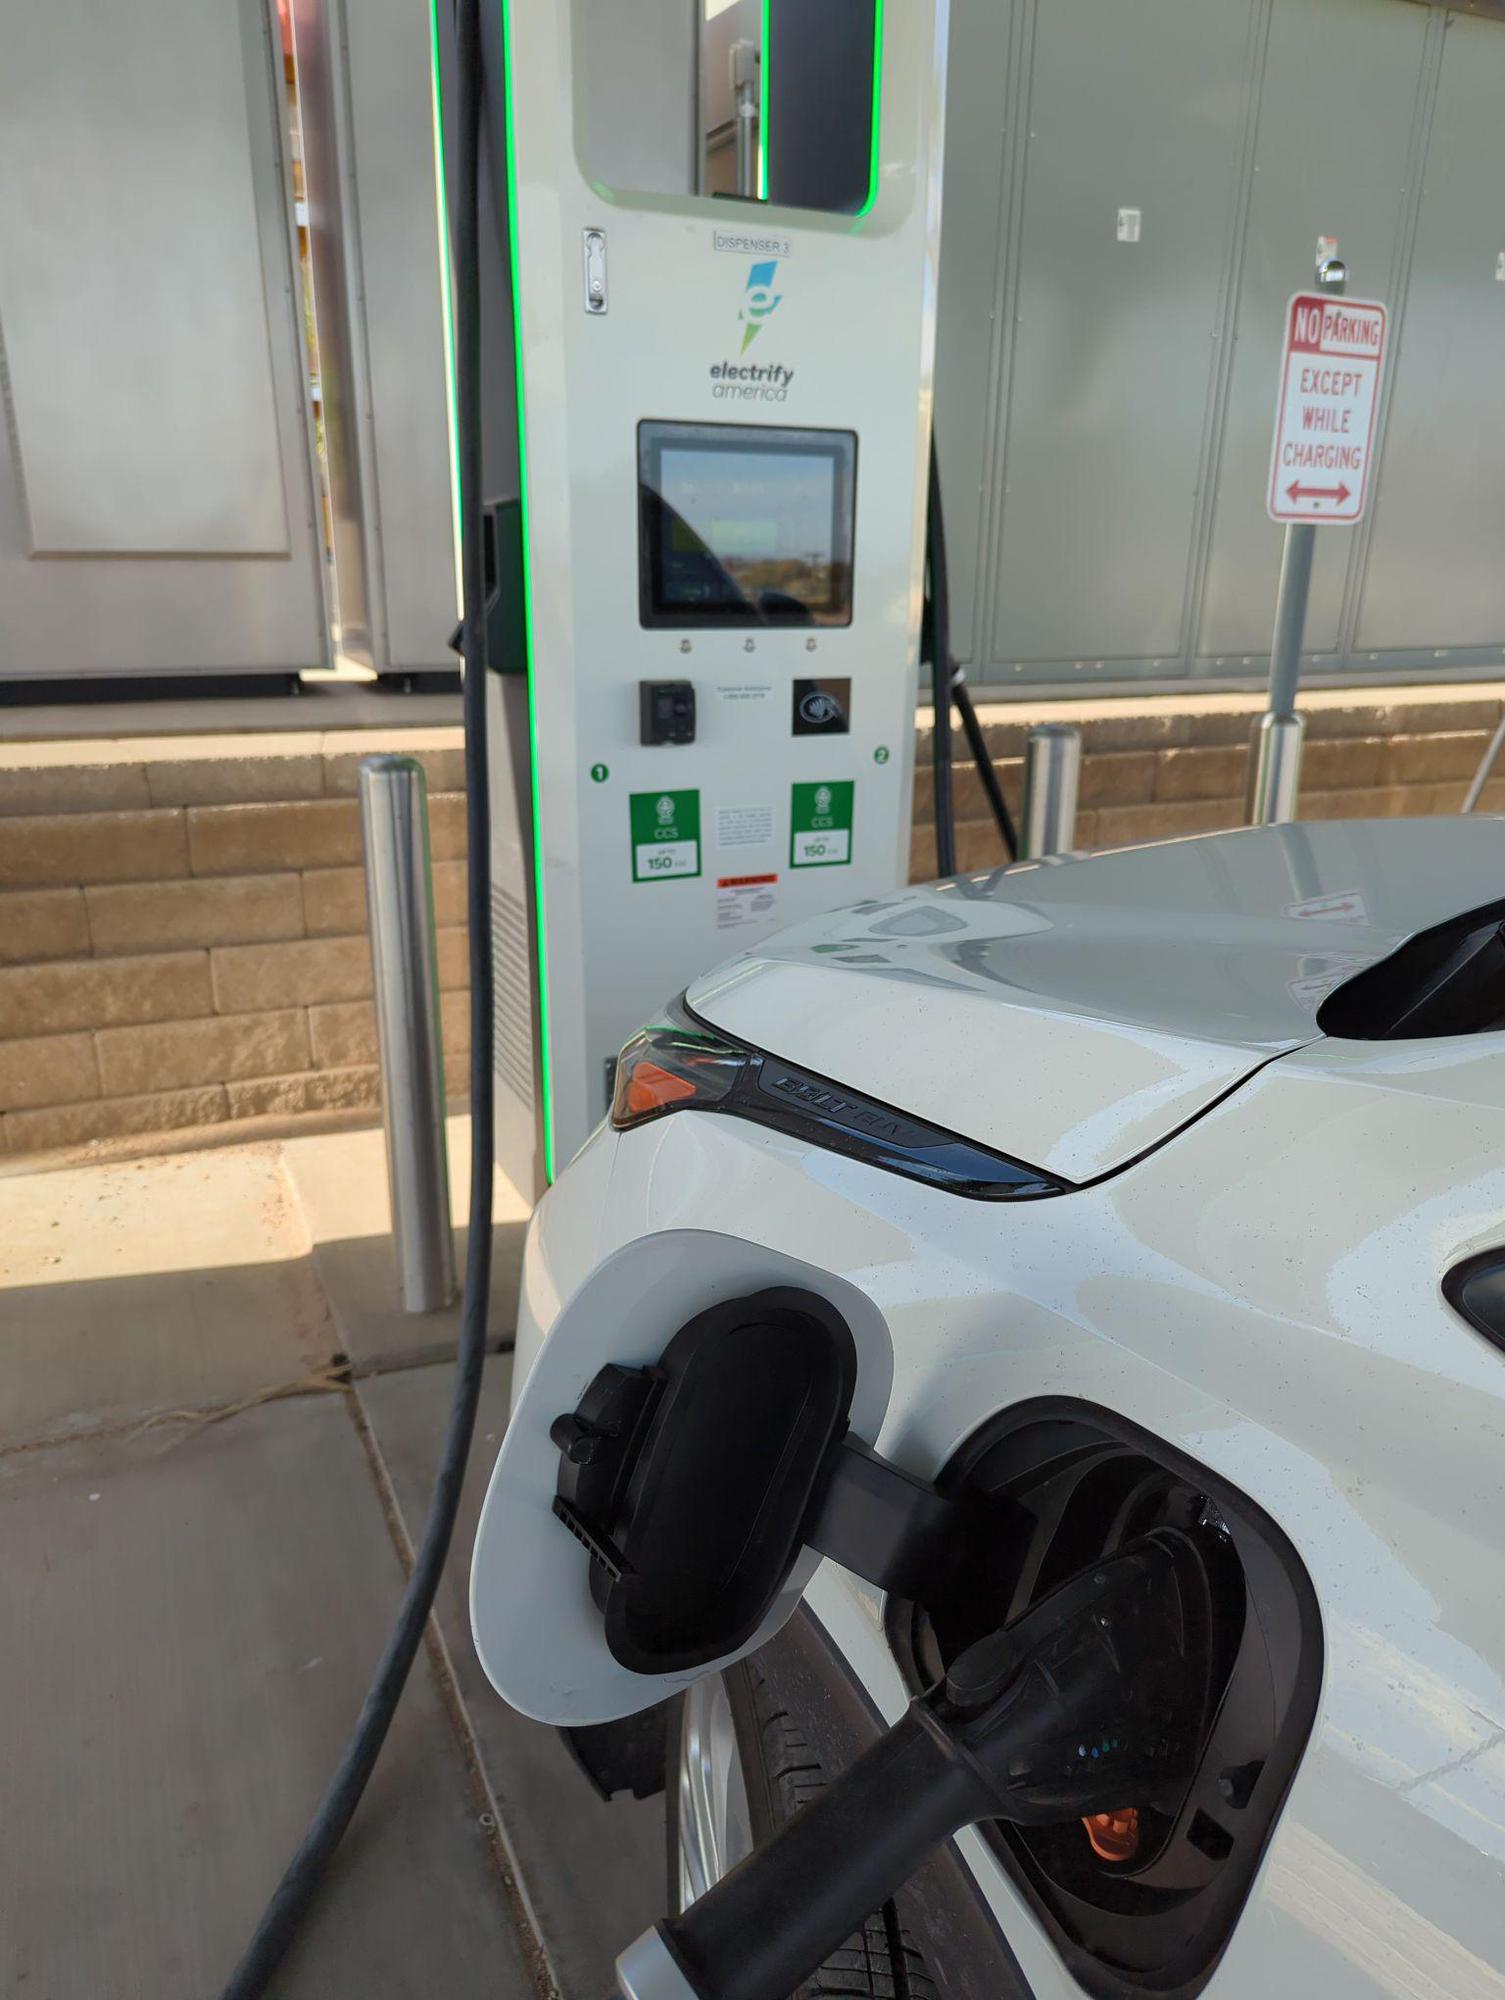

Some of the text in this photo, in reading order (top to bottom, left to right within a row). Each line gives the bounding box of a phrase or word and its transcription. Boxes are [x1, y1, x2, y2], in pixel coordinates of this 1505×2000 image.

[716, 235, 781, 251] DISPENSER
[1294, 307, 1379, 346] NO PARKING
[710, 361, 794, 387] electrify
[1300, 367, 1362, 397] EXCEPT
[712, 384, 788, 402] america
[1302, 406, 1350, 434] WHILE
[1282, 443, 1362, 471] CHARGING
[648, 857, 673, 870] 150
[804, 845, 826, 857] 150
